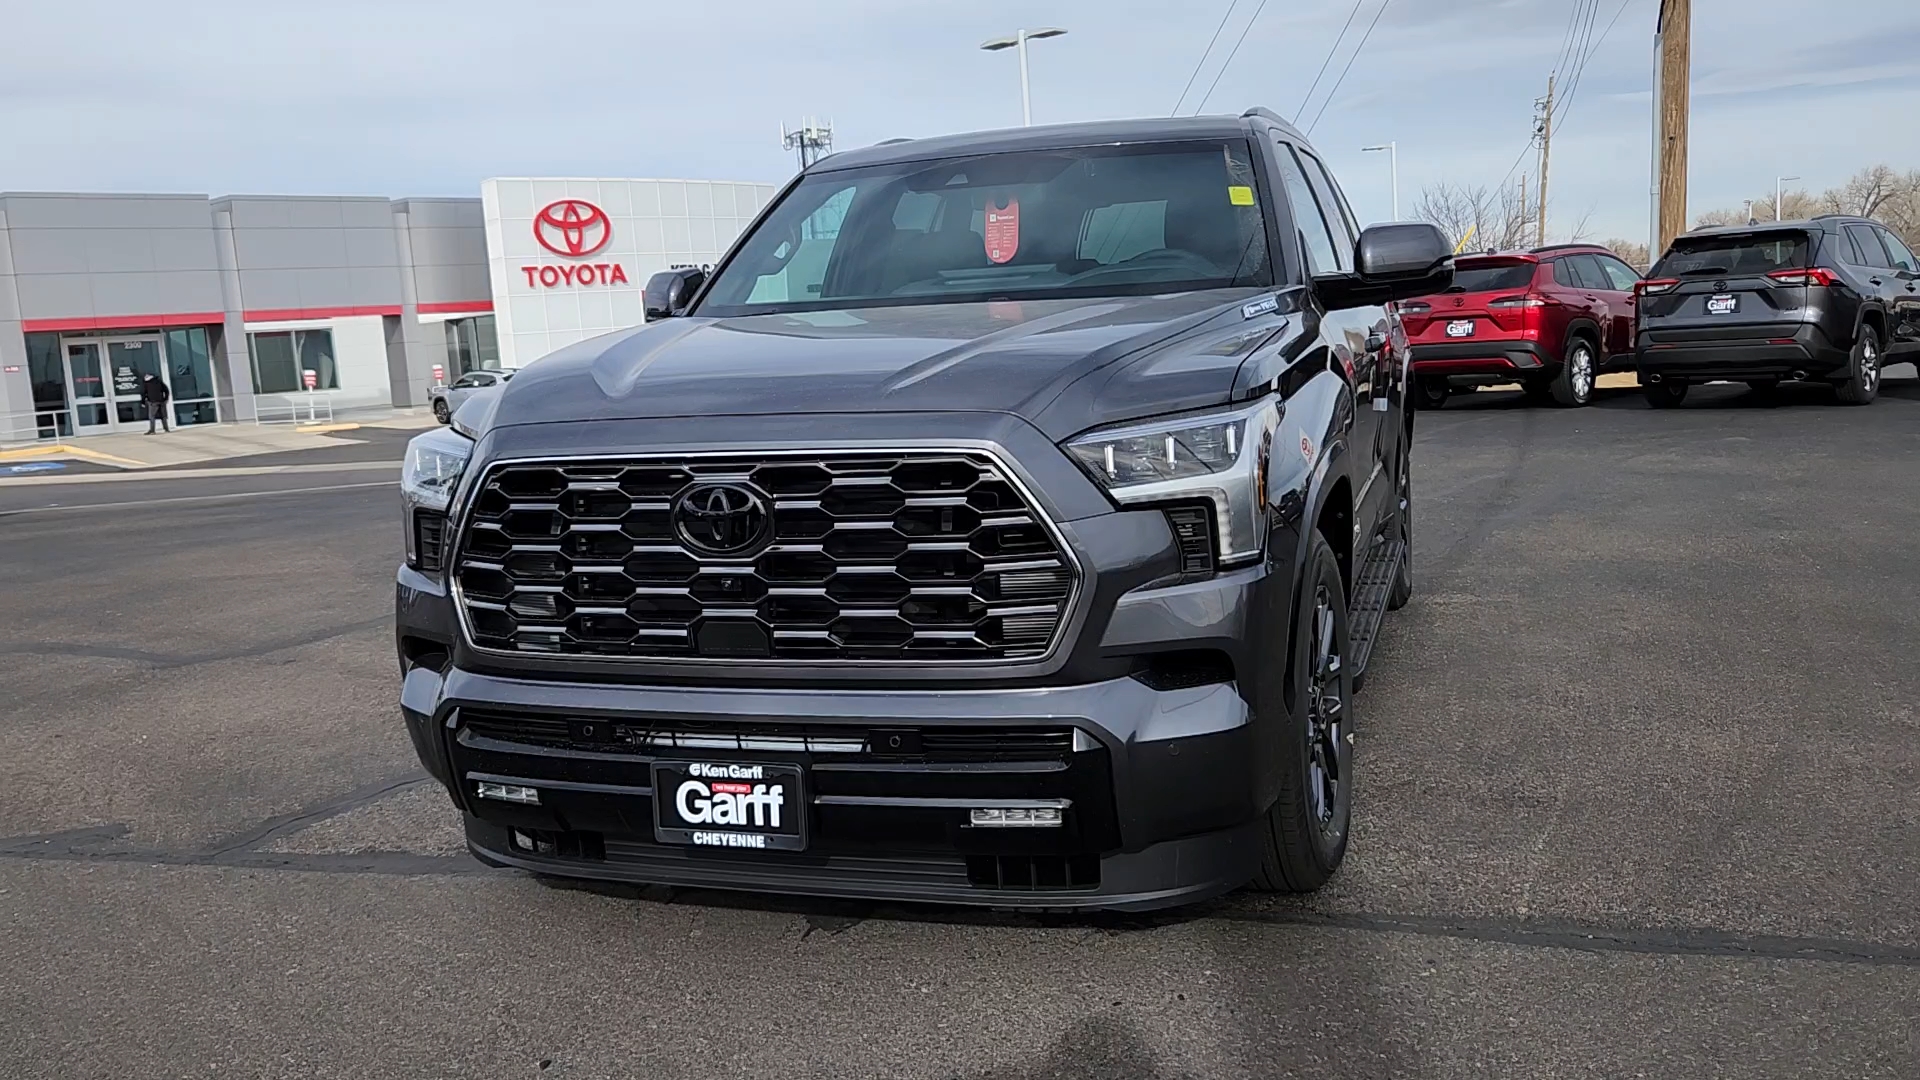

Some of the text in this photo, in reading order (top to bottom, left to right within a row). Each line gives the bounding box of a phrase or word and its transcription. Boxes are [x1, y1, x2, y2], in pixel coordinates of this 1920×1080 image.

[521, 264, 628, 288] TOYOTA
[1707, 298, 1736, 310] Garff
[1446, 322, 1474, 335] Garff
[701, 764, 763, 779] Ken Garff
[676, 780, 783, 827] Garff
[693, 832, 765, 848] CHEYENNE
